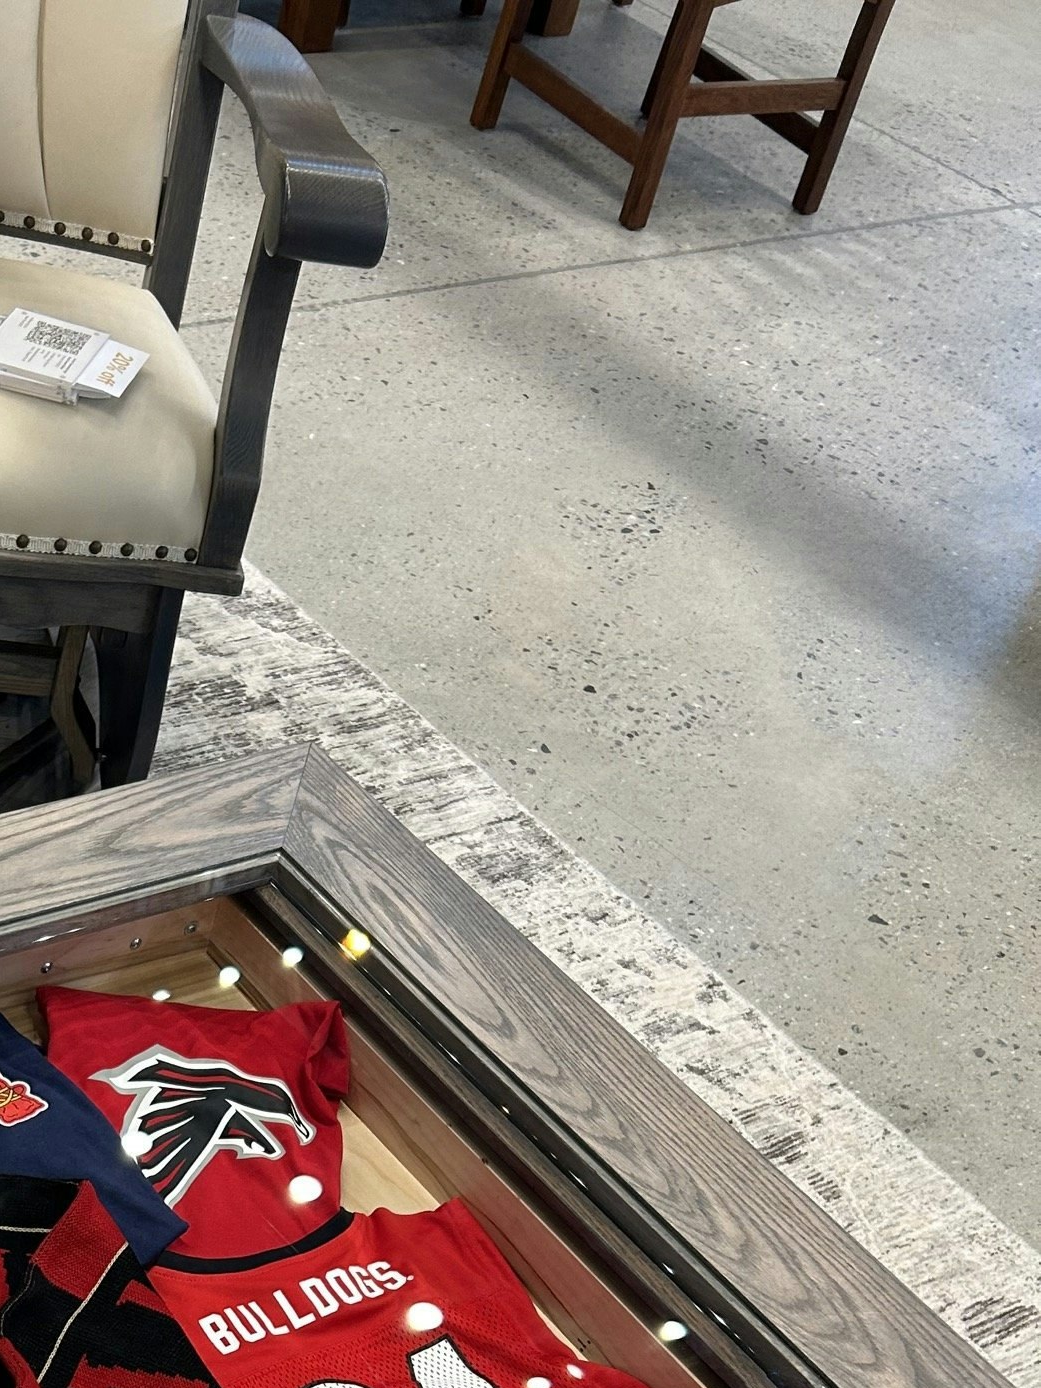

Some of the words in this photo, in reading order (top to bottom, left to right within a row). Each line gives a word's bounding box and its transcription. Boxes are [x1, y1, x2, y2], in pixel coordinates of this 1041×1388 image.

[106, 352, 134, 375] 20%
[96, 371, 116, 387] off
[198, 1261, 409, 1355] BULLDOGS
